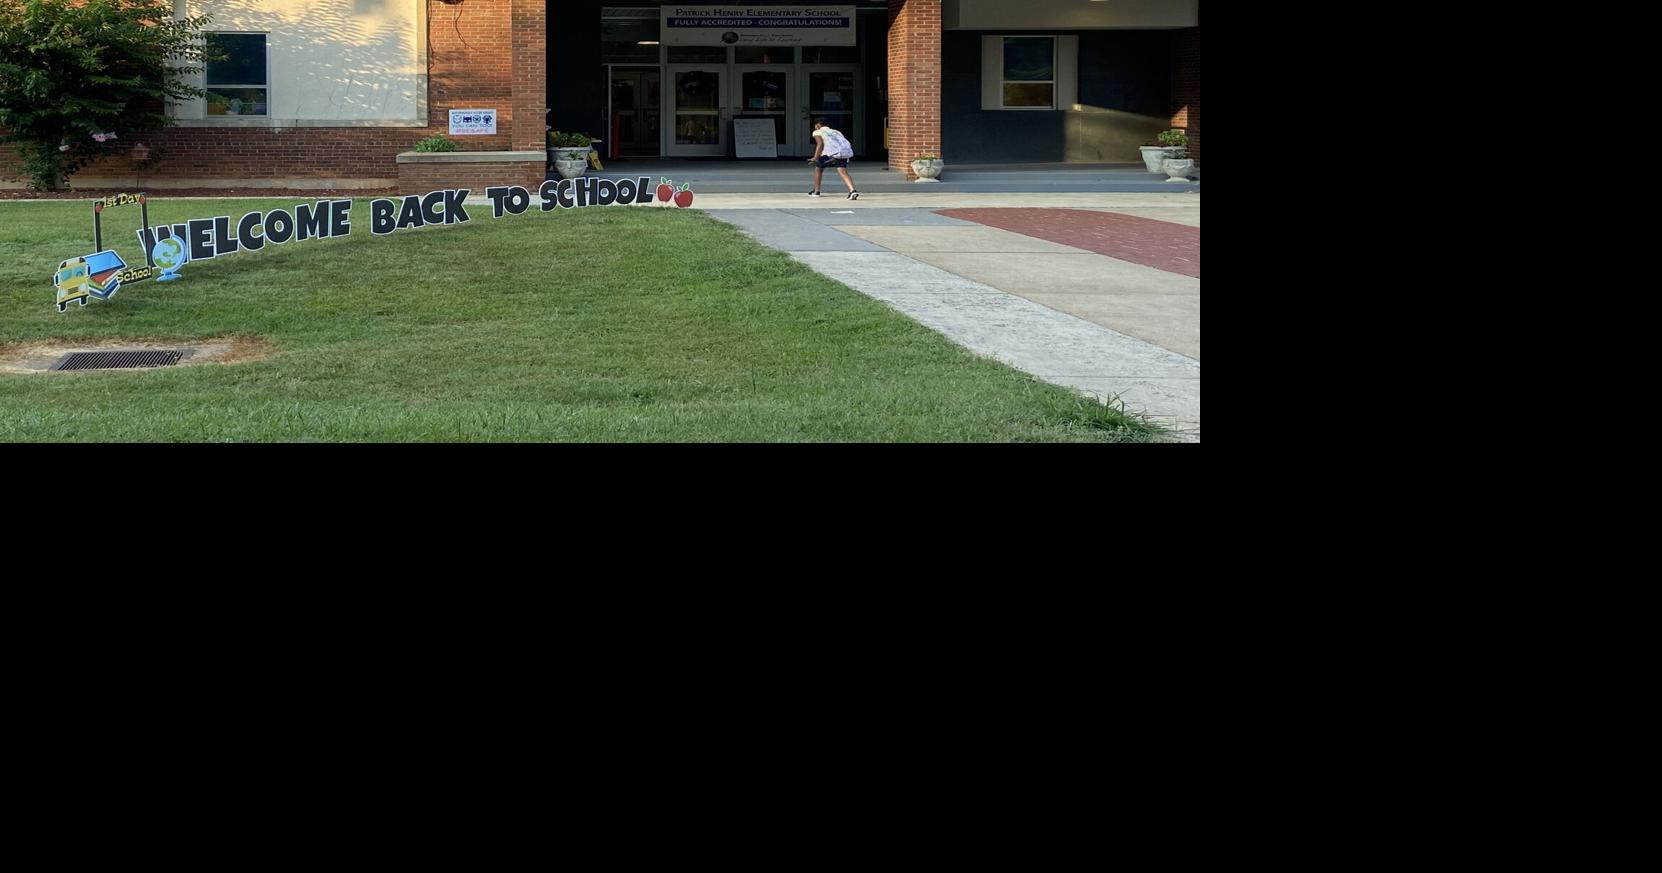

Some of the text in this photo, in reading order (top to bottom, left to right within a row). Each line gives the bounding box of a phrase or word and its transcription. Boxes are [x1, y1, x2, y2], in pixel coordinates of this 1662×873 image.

[675, 8, 842, 17] PATRICK HENRY ELEMENTARY SCHOOL
[103, 193, 141, 208] 1st Day
[136, 176, 654, 269] WELCOME BACK TO SCHOOL
[115, 266, 152, 283] School
